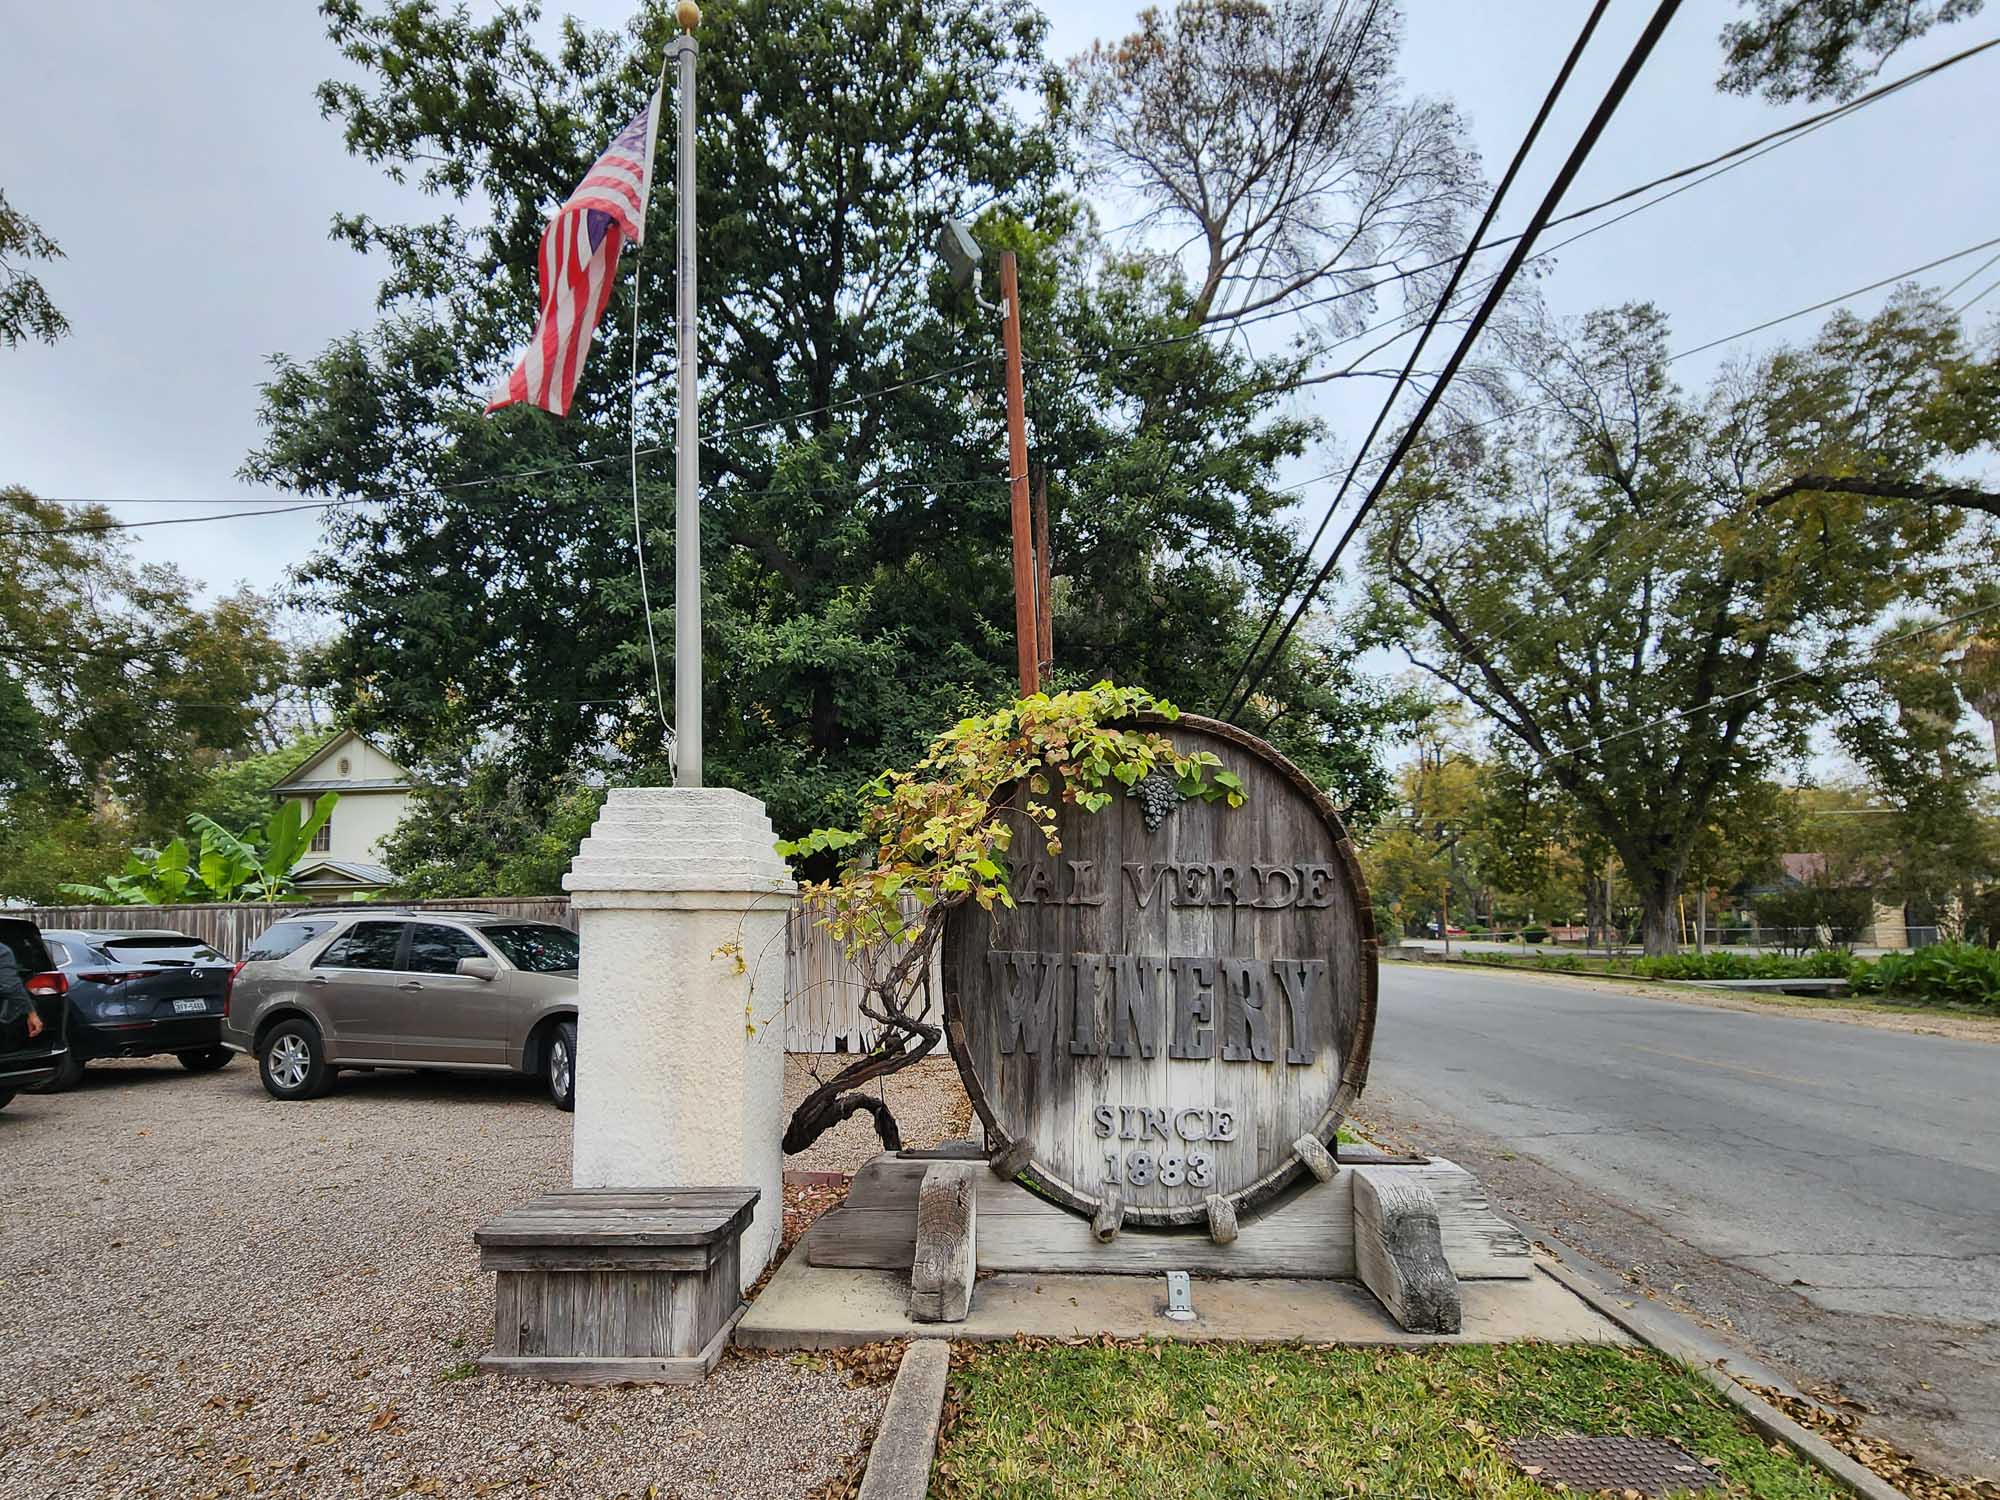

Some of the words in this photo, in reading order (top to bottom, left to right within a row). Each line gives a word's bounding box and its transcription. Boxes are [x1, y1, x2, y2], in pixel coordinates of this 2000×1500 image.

[1123, 861, 1334, 909] VERDE
[986, 950, 1325, 1064] WINERY
[1095, 1104, 1235, 1142] SINCE
[1103, 1150, 1214, 1188] 1883
